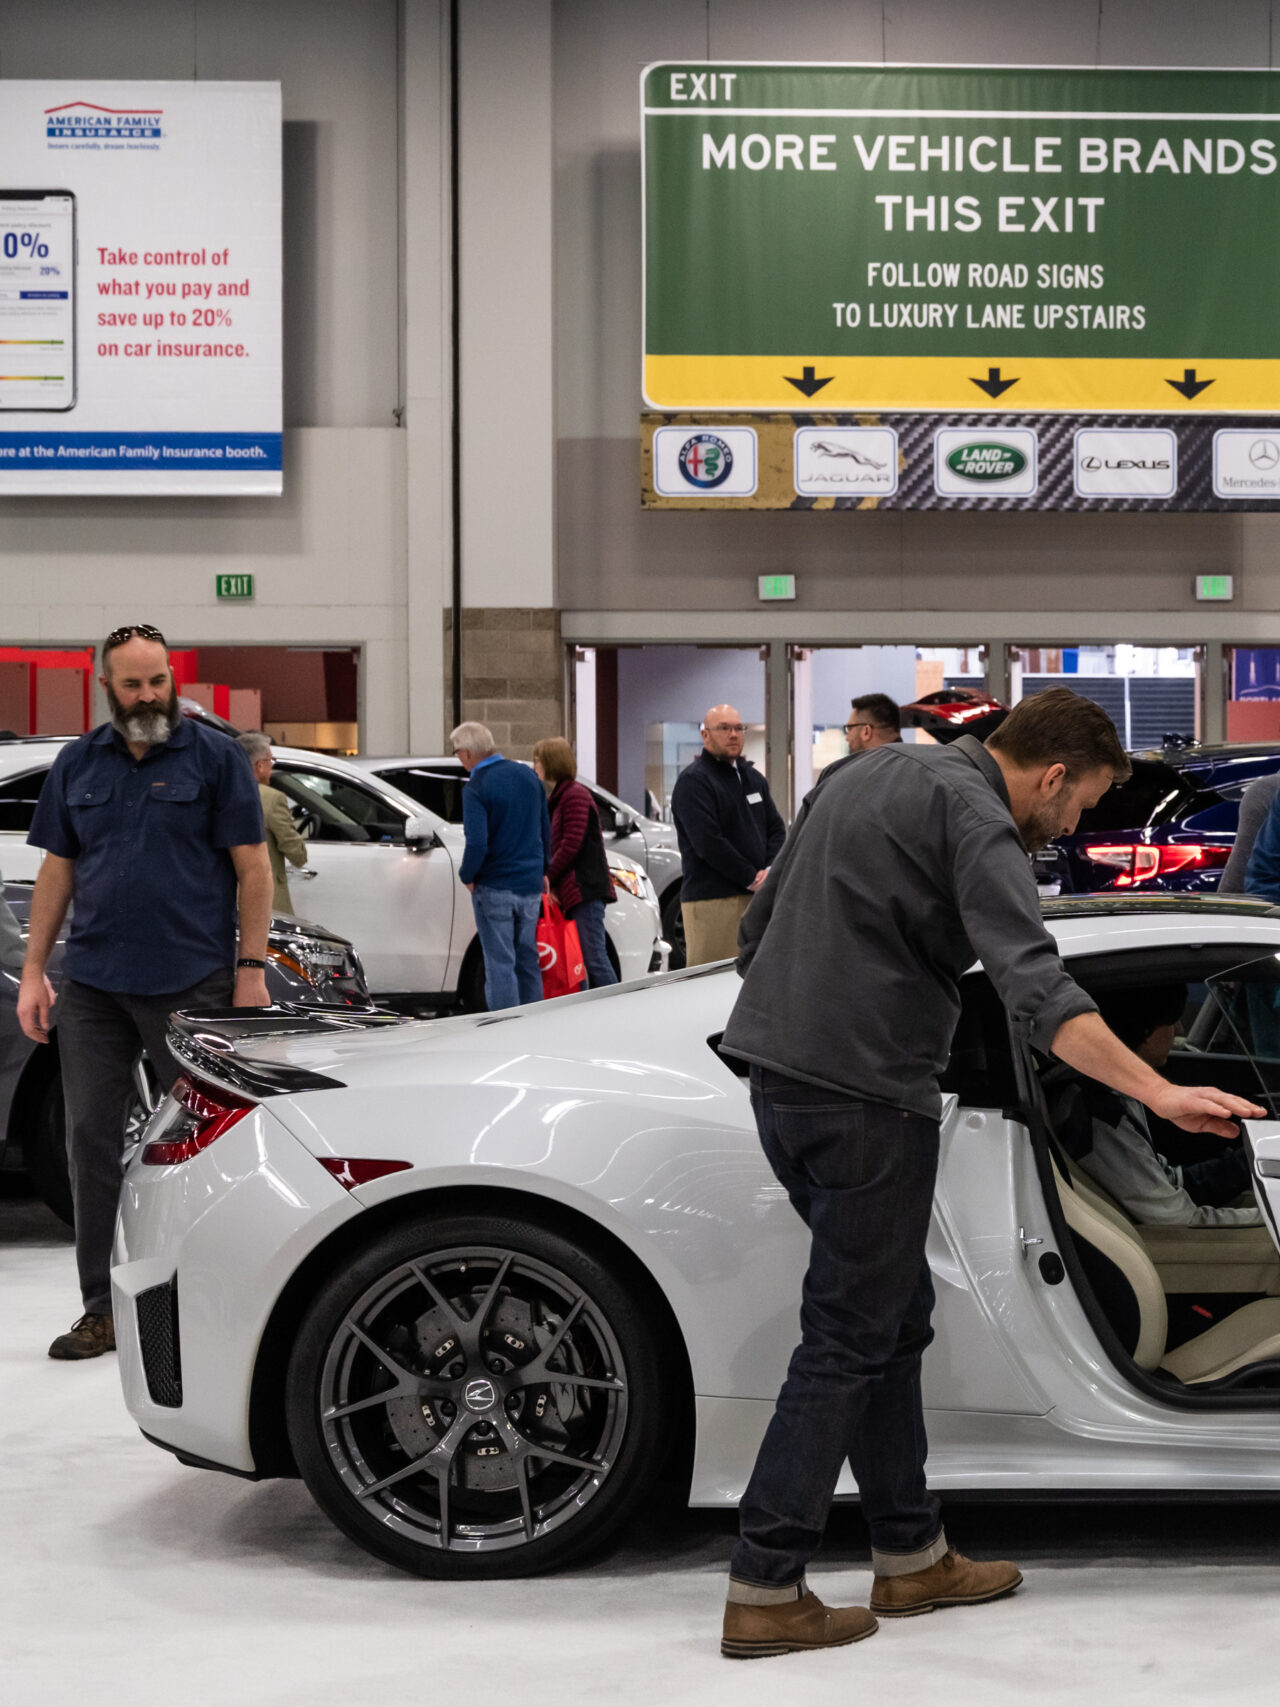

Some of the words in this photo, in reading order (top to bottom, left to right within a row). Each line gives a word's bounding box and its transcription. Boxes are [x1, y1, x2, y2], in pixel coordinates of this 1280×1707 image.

[670, 72, 738, 102] EXIT
[47, 116, 112, 126] AMERICAN
[116, 116, 161, 126] FAMILY
[54, 128, 153, 137] INSURANCE
[702, 134, 838, 171] MORE
[852, 135, 1062, 172] VEHICLE
[1079, 137, 1278, 176] BRANDS
[874, 195, 982, 232] THIS
[998, 197, 1105, 233] EXIT
[97, 247, 139, 266] Take
[143, 247, 206, 266] control
[211, 248, 229, 266] of
[867, 262, 960, 288] FOLLOW
[968, 263, 1029, 288] ROAD
[1036, 264, 1104, 289] SIGNS
[97, 278, 141, 296] what
[145, 282, 177, 300] you
[181, 282, 213, 300] pay
[217, 279, 250, 297] and
[97, 312, 138, 327] save
[143, 312, 165, 330] up
[169, 310, 187, 327] to
[191, 308, 233, 328] 20%
[832, 302, 861, 328] TO
[868, 303, 958, 329] LUXURY
[966, 304, 1026, 329] LANE
[1033, 304, 1146, 330] UPSTAIRS
[97, 343, 119, 357] on
[123, 343, 152, 357] car
[156, 339, 249, 358] insurance.
[18, 446, 31, 458] at
[34, 445, 55, 458] the
[57, 445, 117, 458] American
[119, 445, 160, 460] Family
[162, 445, 223, 458] Insurance
[225, 445, 268, 458] booth.
[679, 439, 698, 462] ALFA
[702, 435, 732, 463] ROMEO
[961, 448, 1002, 461] LAND
[964, 462, 1015, 474] ROVER
[1104, 459, 1171, 470] LEXUS
[800, 473, 890, 482] JAGUAR
[221, 577, 249, 596] EXIT
